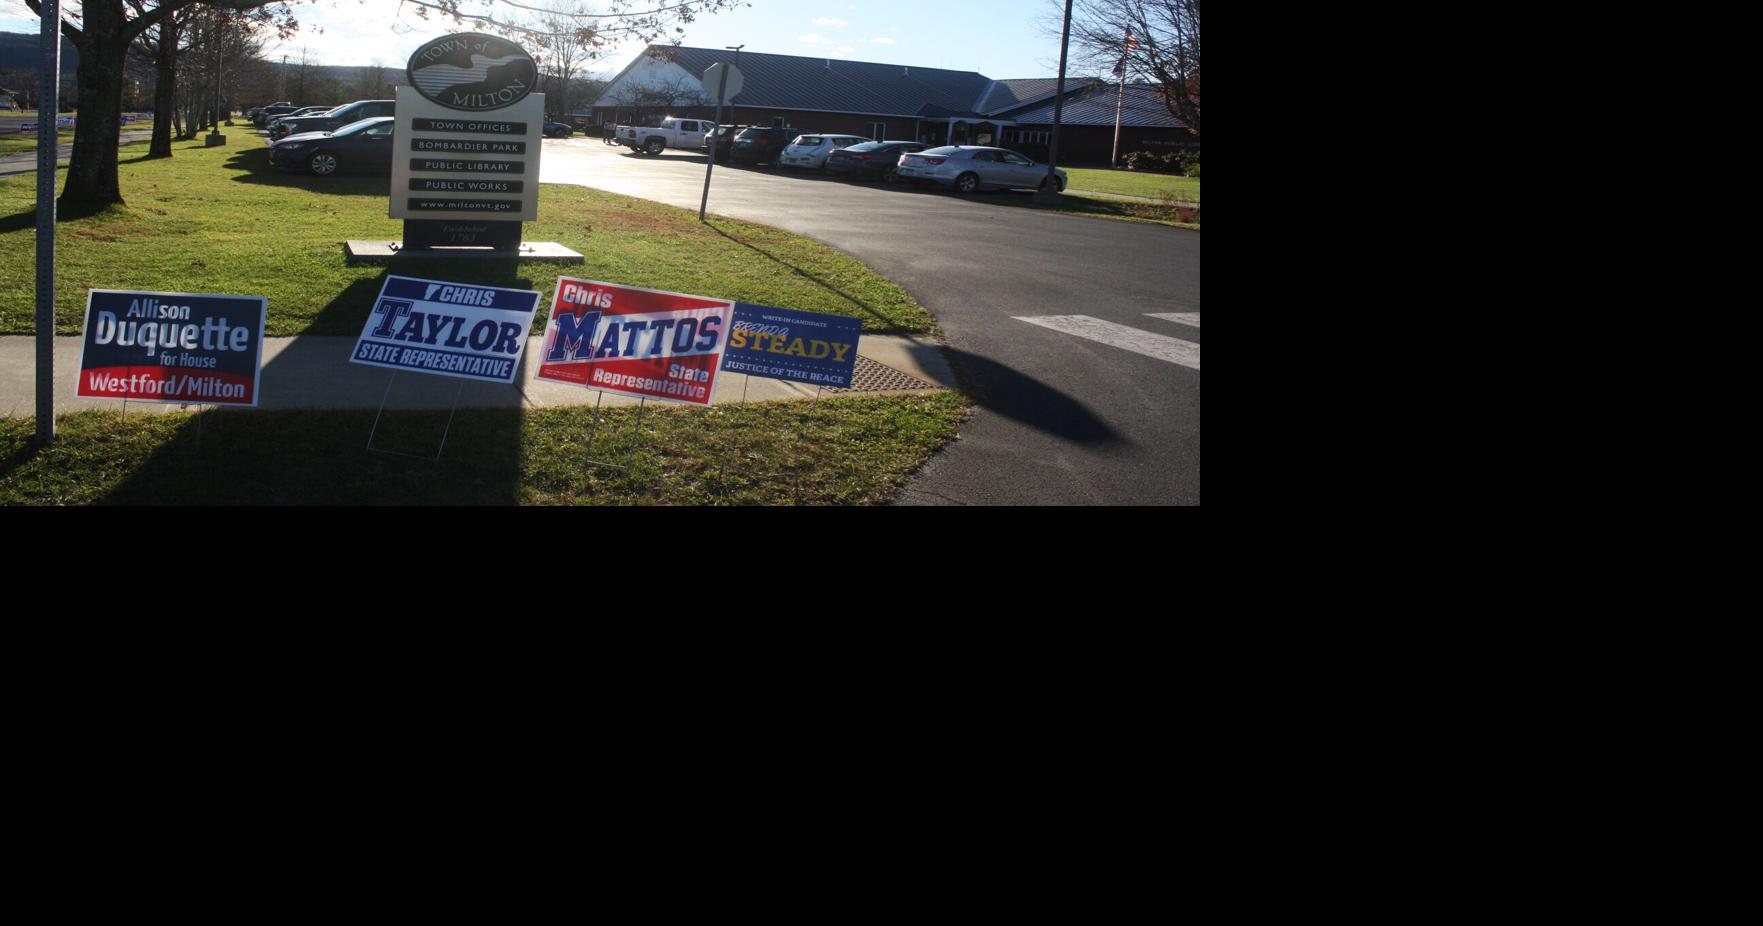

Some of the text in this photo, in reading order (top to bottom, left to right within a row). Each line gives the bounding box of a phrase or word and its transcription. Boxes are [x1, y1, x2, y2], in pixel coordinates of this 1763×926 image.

[421, 39, 489, 62] TOWN of
[452, 78, 526, 108] MILTON
[430, 121, 511, 132] TOWN OFFICES
[418, 141, 519, 152] BOMBARDIER PARK
[425, 161, 510, 171] PUBLIC LIBRARY
[425, 181, 508, 191] PUBLIC WORKS
[420, 201, 511, 211] www.miltonvt.gov
[439, 286, 496, 307] CHRIS
[562, 283, 613, 309] Chris
[126, 298, 191, 320] Allison
[94, 310, 249, 356] Duquette
[371, 297, 523, 355] TAYLOR
[791, 318, 828, 328] CANDIDATE
[547, 311, 722, 361] MATTOS
[729, 329, 852, 362] STEADY
[160, 351, 217, 368] for House
[358, 343, 512, 377] STATE REPRESENTATIVE
[593, 368, 706, 399] Representative
[668, 363, 710, 383] State
[725, 360, 845, 384] JUSTICE OF THE PEACE
[89, 371, 245, 398] Westford/Milton
